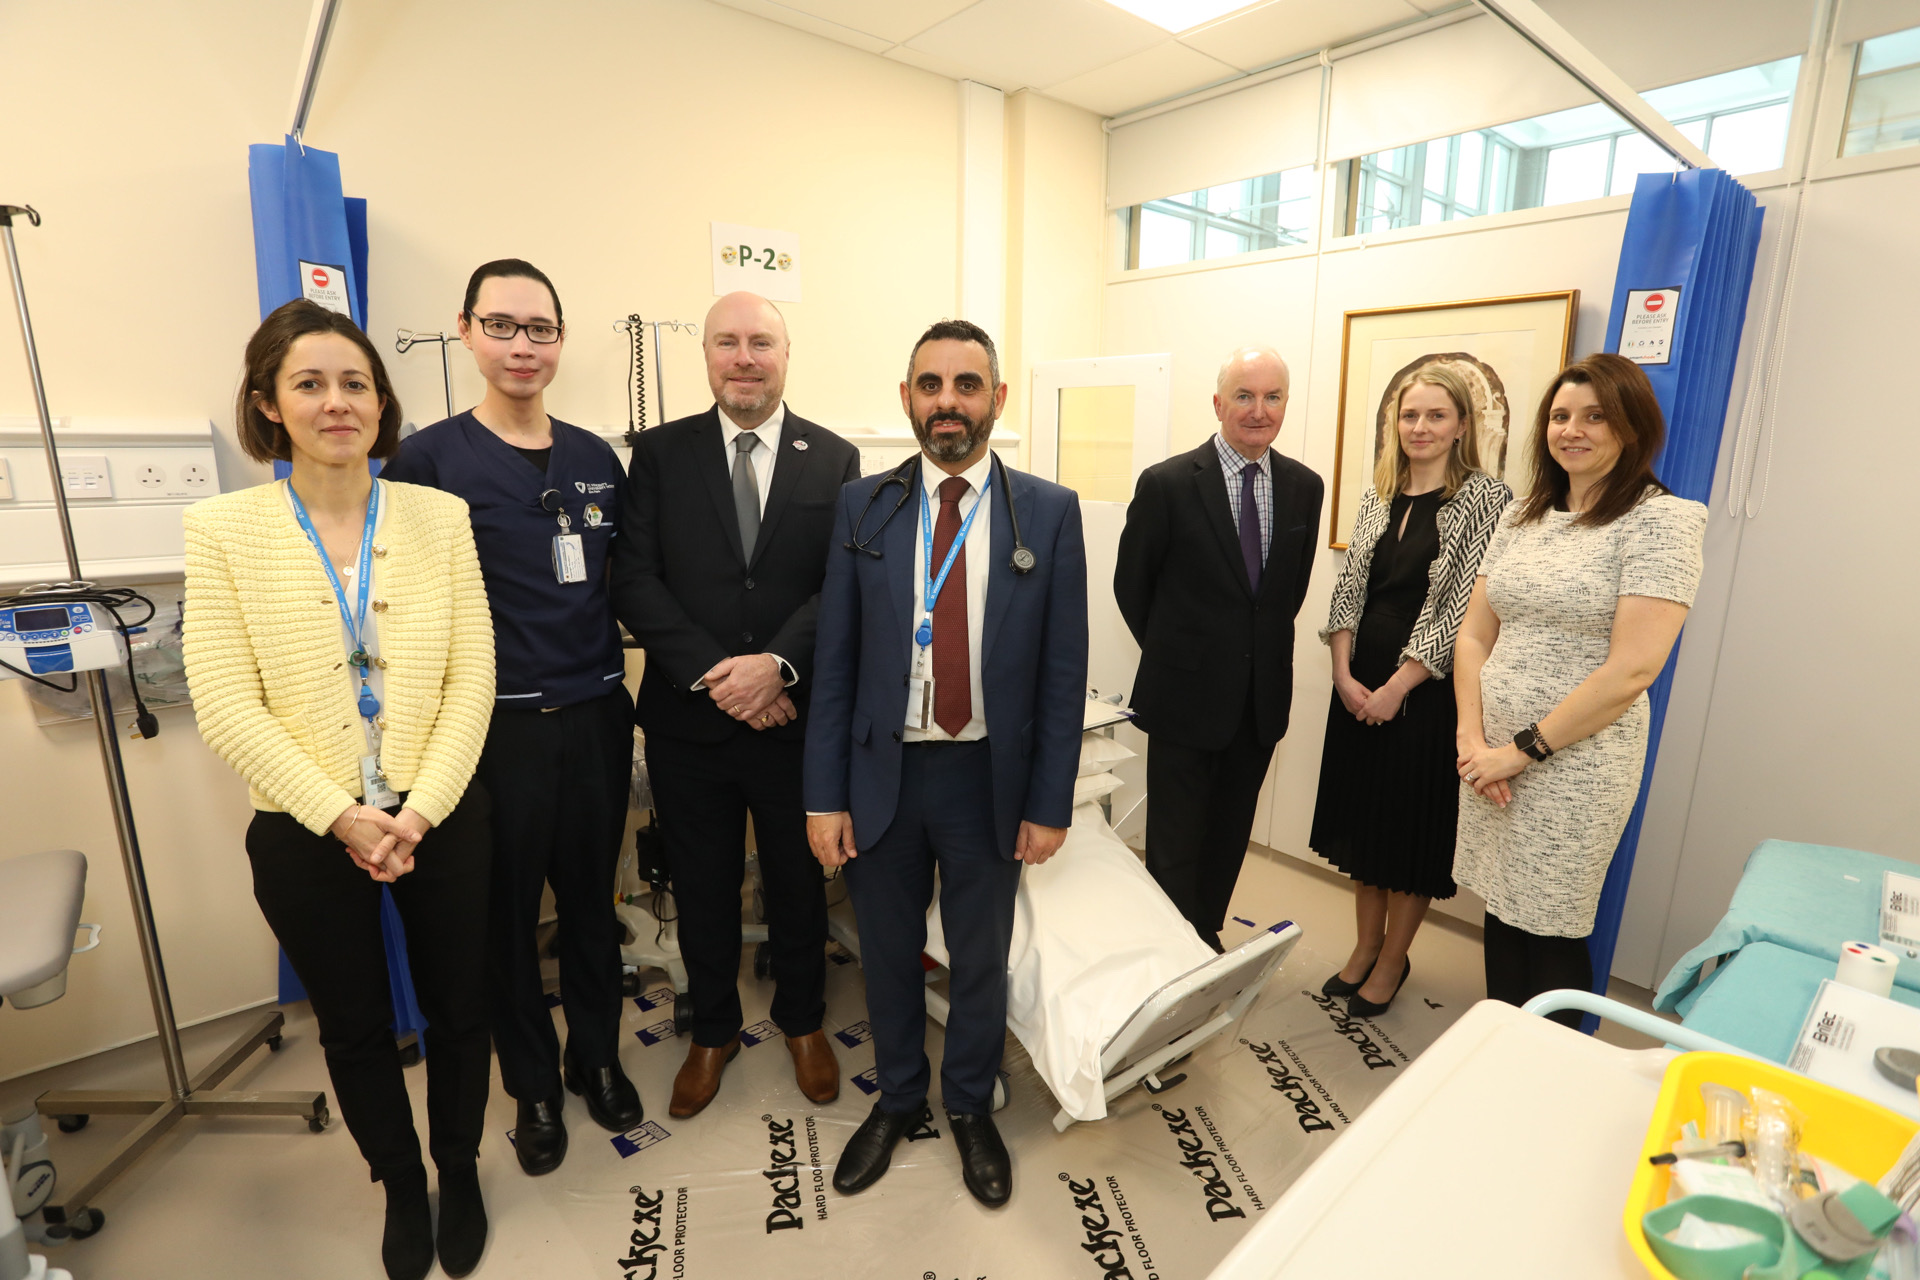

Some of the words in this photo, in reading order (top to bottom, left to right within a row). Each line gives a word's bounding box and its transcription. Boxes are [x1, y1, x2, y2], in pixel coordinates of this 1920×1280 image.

[739, 244, 776, 270] P-2
[1278, 1040, 1313, 1078] PROTECTOR
[1390, 1043, 1410, 1063] HARD
[1309, 1078, 1332, 1102] FLOOR
[1195, 1105, 1229, 1153] PROTECTOR
[1330, 1103, 1351, 1124] HARD
[805, 1115, 821, 1167] PROTECTOR
[1224, 1153, 1248, 1183] FLOOR
[816, 1194, 828, 1220] HARD
[1106, 1175, 1138, 1232] PROTECTOR
[1243, 1184, 1265, 1211] HARD
[674, 1186, 689, 1246] PROTECTOR
[672, 1248, 685, 1280] LOOR
[1131, 1234, 1155, 1270] FLOOR
